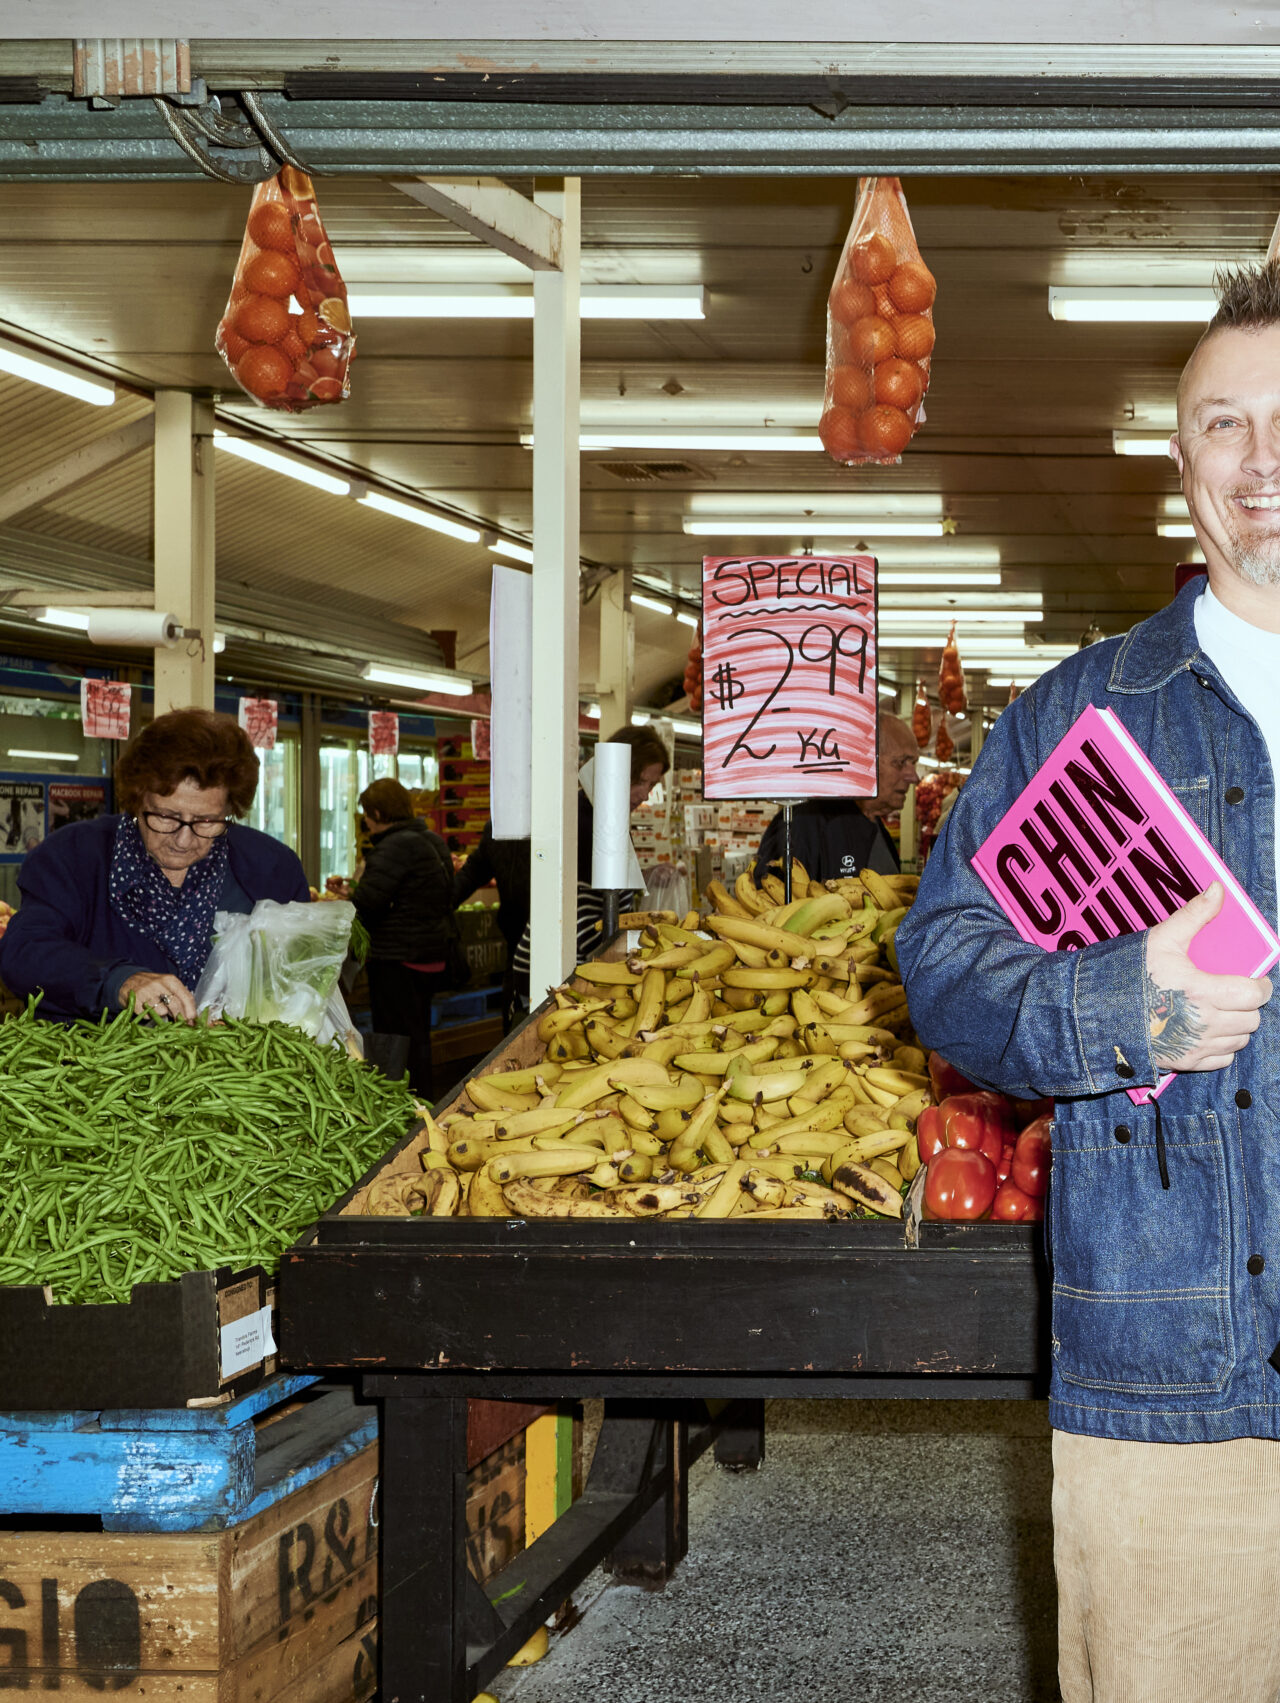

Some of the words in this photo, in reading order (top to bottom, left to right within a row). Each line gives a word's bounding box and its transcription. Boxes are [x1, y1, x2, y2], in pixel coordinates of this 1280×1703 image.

[711, 560, 872, 606] SPECIAL
[797, 728, 841, 763] KG
[14, 786, 40, 797] REPAIR
[50, 788, 81, 799] MACBOOK
[83, 789, 104, 799] REPAIR
[996, 738, 1150, 936] CHIN
[1057, 825, 1204, 952] IN
[467, 942, 503, 969] FRUIT
